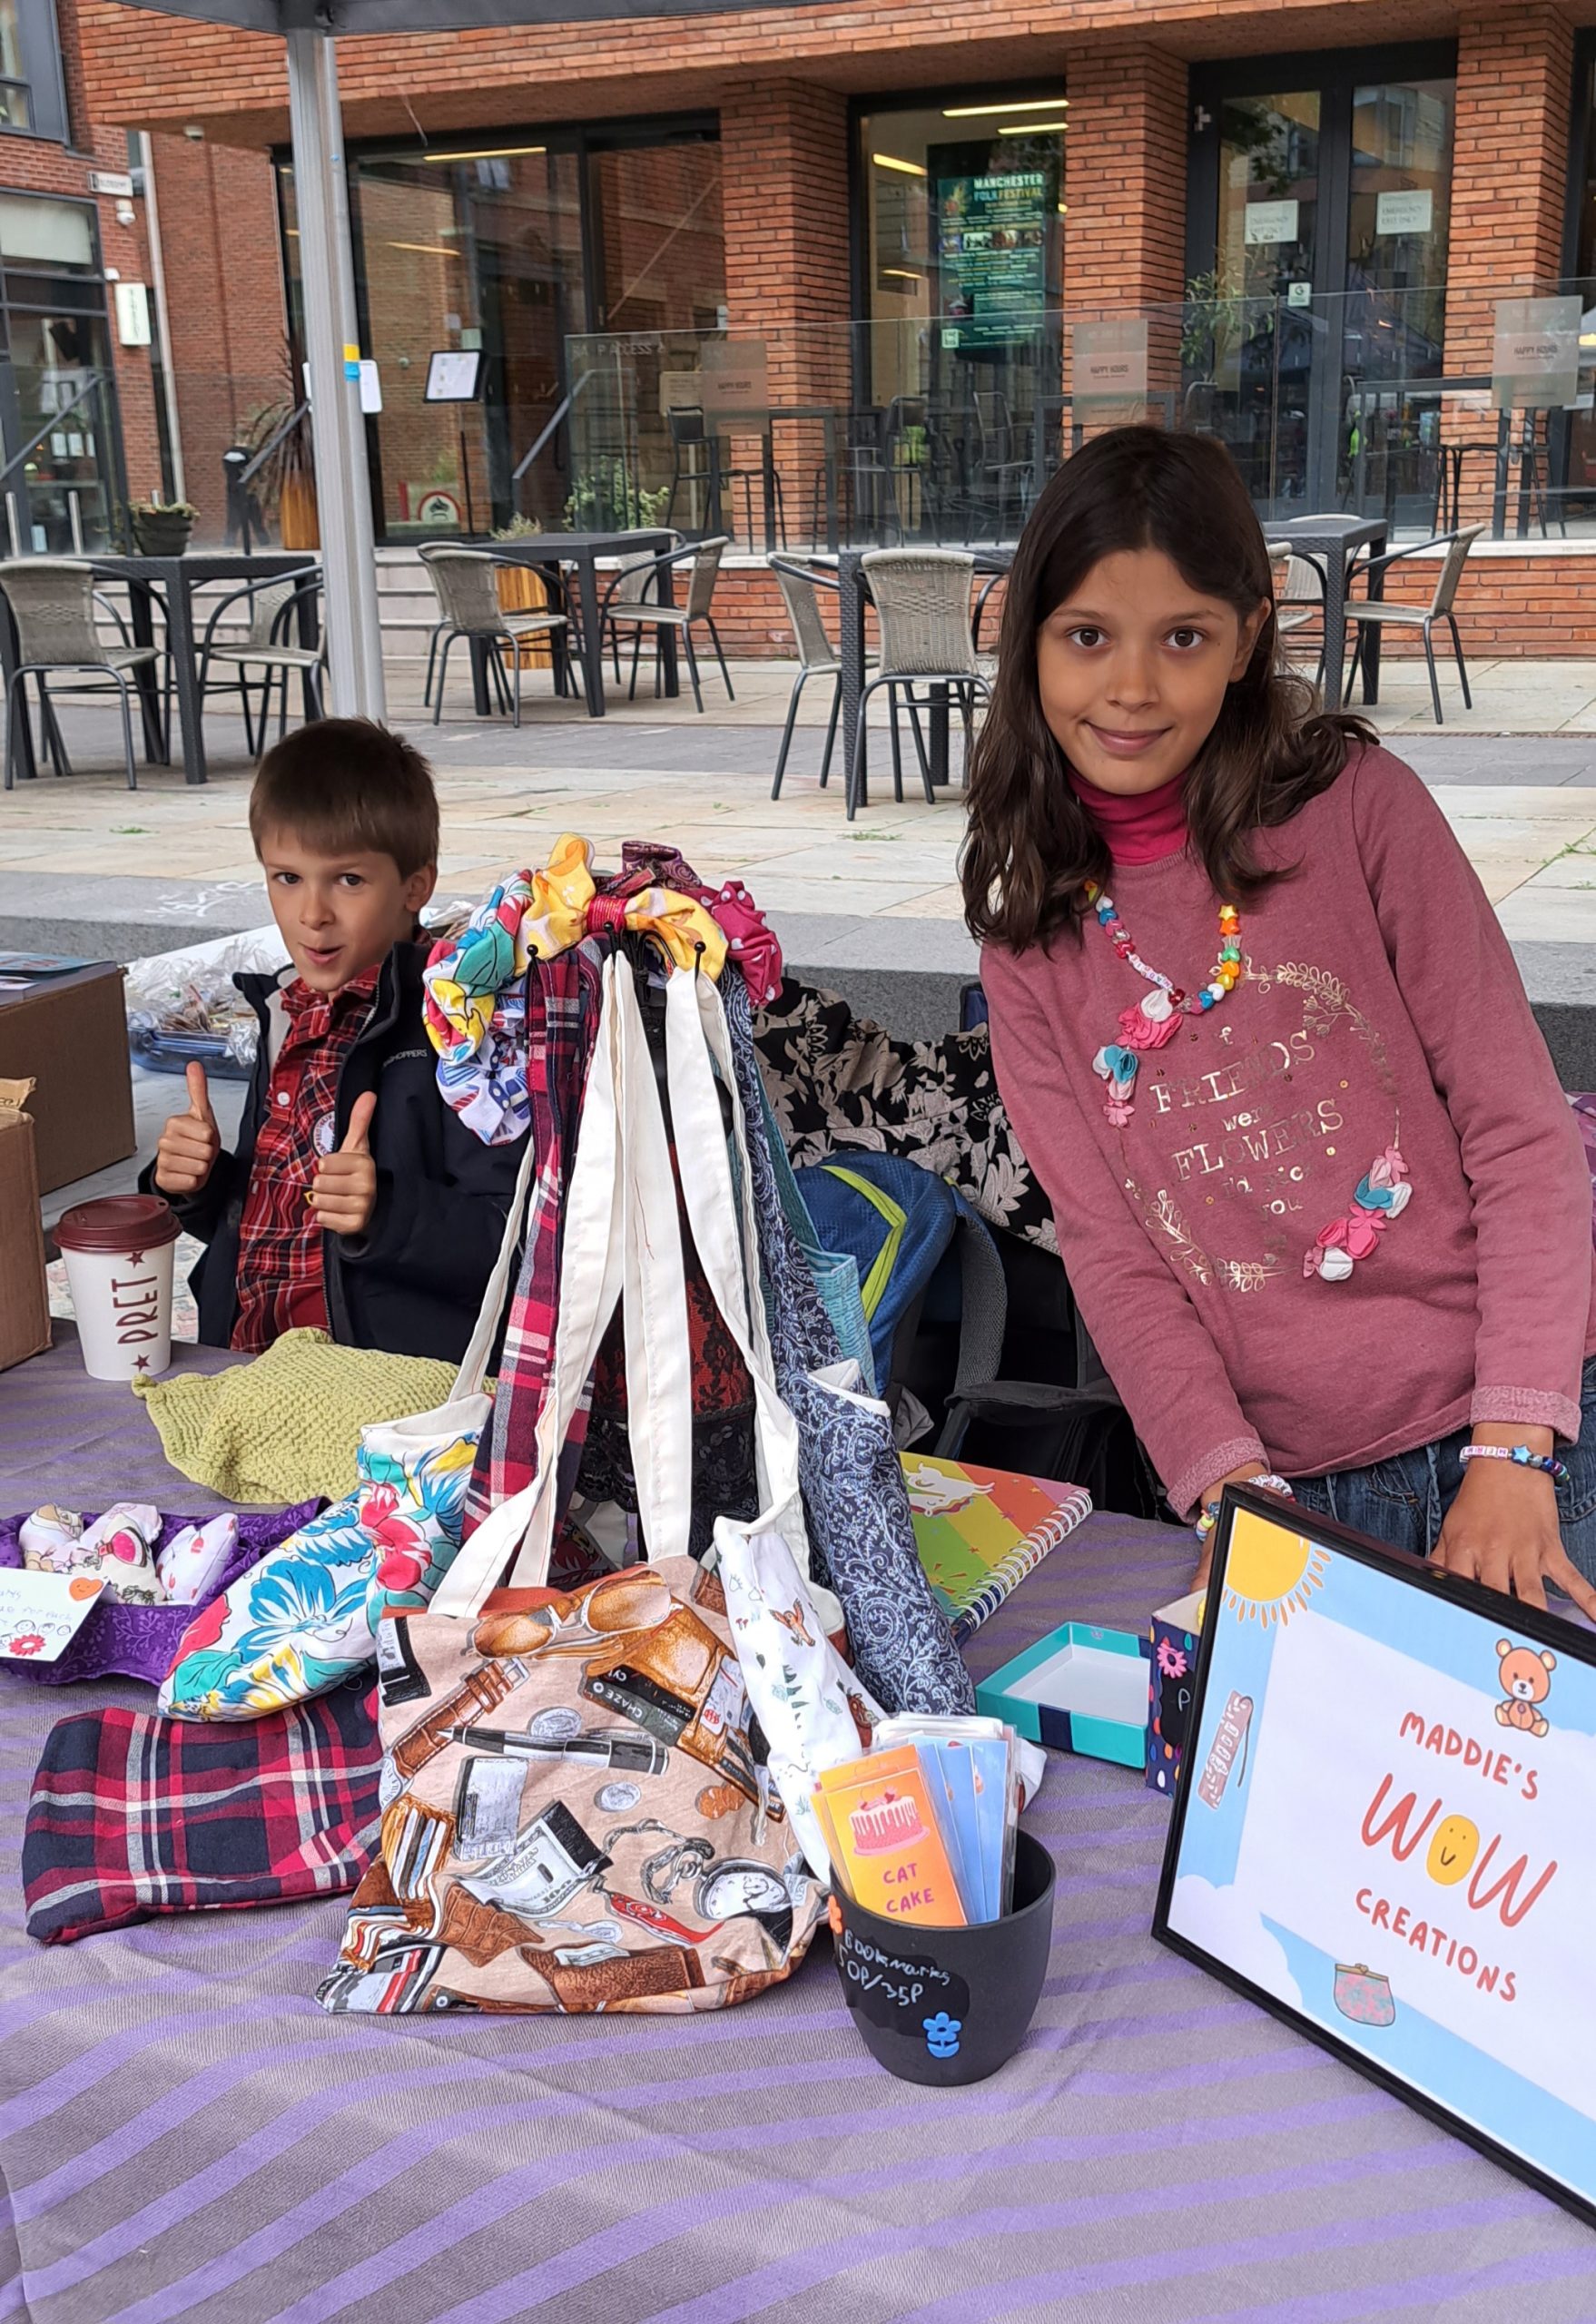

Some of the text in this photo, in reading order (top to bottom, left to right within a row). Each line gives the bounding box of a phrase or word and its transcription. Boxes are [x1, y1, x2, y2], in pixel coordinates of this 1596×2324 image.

[973, 173, 1043, 189] MANCHESTER
[999, 187, 1043, 200] FESTIVAL
[1171, 1098, 1344, 1181] FLOWERS
[111, 1275, 159, 1344] PRET
[1399, 1711, 1539, 1800] MADDIE'S
[883, 1863, 918, 1884] CAT
[1361, 1772, 1559, 1927] WOW
[886, 1888, 935, 1913] CAKE
[1355, 1887, 1518, 2002] CREATIONS
